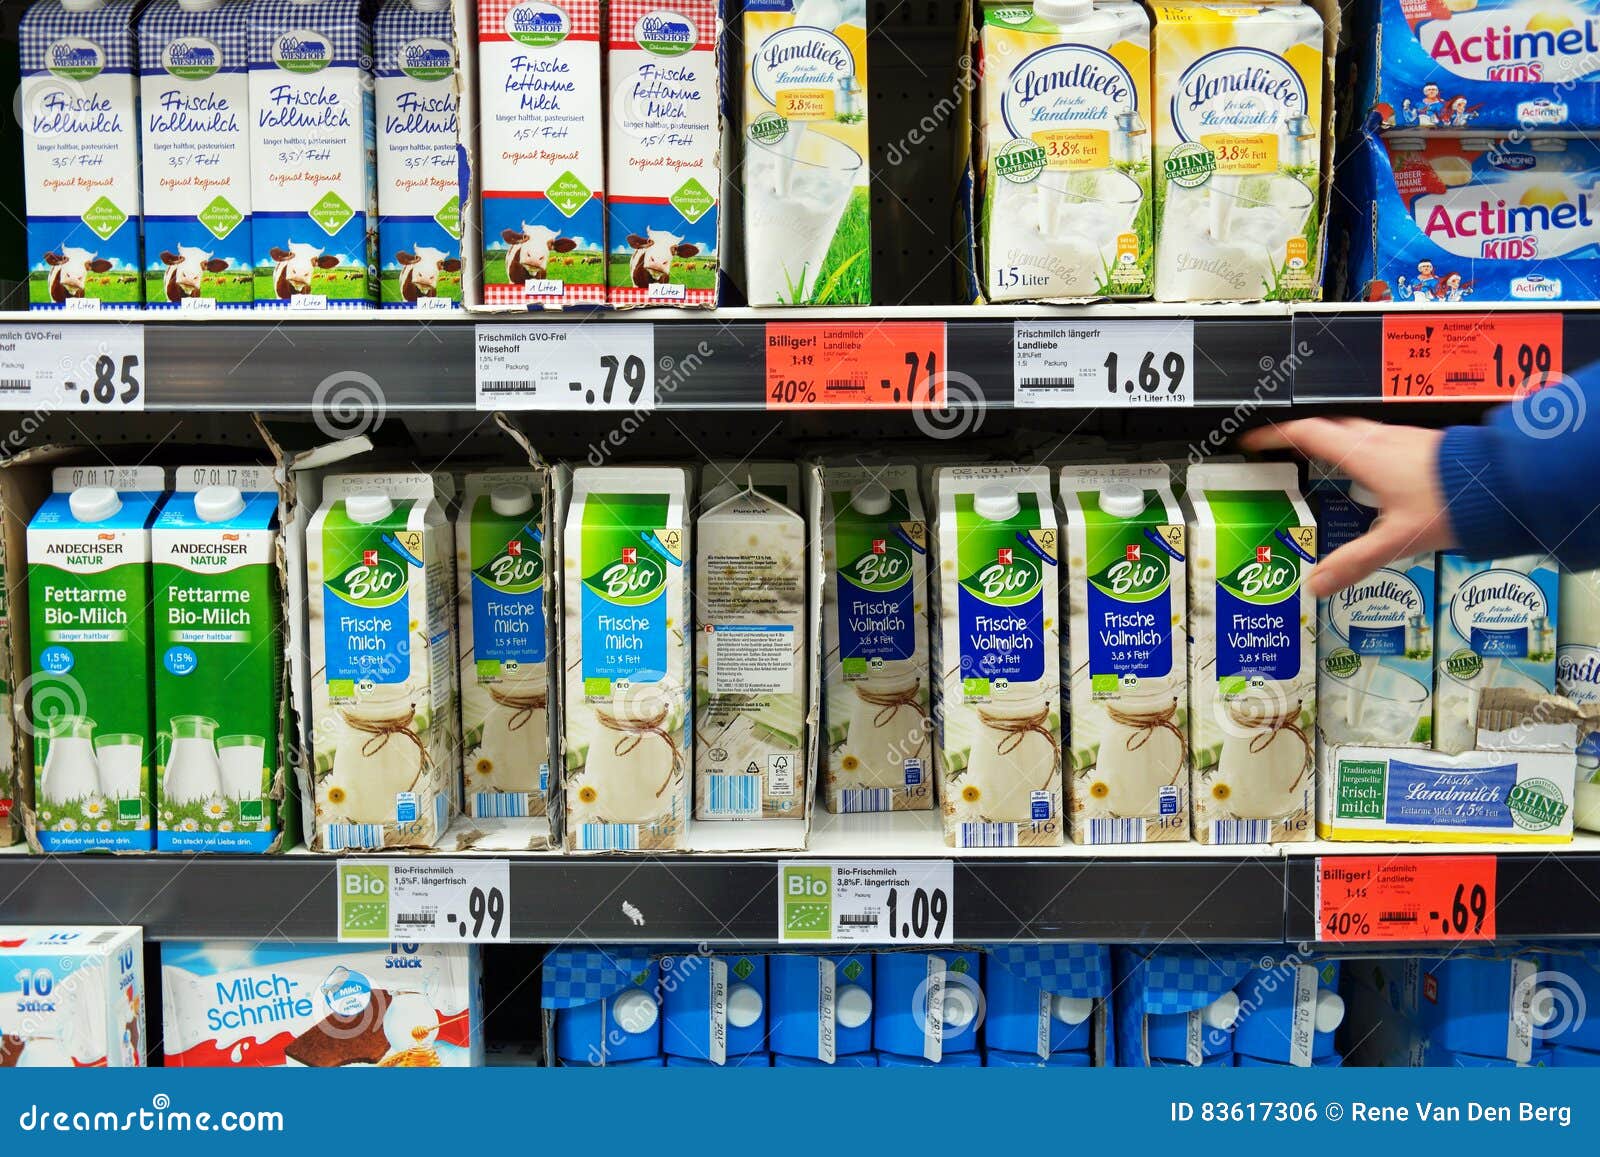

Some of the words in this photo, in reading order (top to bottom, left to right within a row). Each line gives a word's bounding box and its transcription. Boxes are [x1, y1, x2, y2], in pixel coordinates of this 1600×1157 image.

[514, 24, 563, 32] WIESEHOFF
[643, 33, 690, 42] WIESEHOFF
[1431, 20, 1593, 65] Actimel
[53, 58, 97, 67] WIESEHOFF
[170, 57, 215, 66] WIESEHOFF
[280, 51, 325, 60] WIESEHOFF
[407, 59, 450, 68] WIESEHOFF
[764, 40, 847, 71] Landliebe
[511, 56, 569, 73] Frische
[639, 64, 696, 81] Frische
[506, 74, 575, 93] fettarme
[776, 72, 834, 83] Landmilch
[1015, 63, 1128, 108] Landliebe
[270, 85, 339, 105] Frische
[633, 82, 700, 100] fettarme
[1185, 67, 1298, 111] Landliebe
[44, 92, 112, 112] Frische
[160, 90, 229, 111] Frische
[520, 94, 560, 110] Milch
[259, 108, 350, 128] Vollmilch
[647, 102, 686, 118] Milch
[1031, 106, 1108, 122] Landmilch
[1200, 110, 1278, 126] Landmilch
[33, 113, 123, 133] Vollmilch
[150, 112, 240, 133] Vollmilch
[1047, 142, 1080, 156] 3,8%
[1216, 146, 1249, 160] 3,8%
[996, 148, 1045, 167] OHNE
[1165, 152, 1214, 172] OHNE
[1425, 194, 1593, 239] Actimel
[1483, 238, 1536, 259] KIDS
[996, 267, 1019, 288] 1,5
[1022, 274, 1050, 286] Liter
[478, 333, 527, 341] Frischmilch
[529, 333, 567, 341] GVO-Frei
[824, 331, 863, 339] Landmilch
[1018, 330, 1066, 338] Frischmilch
[1387, 327, 1434, 343] Werbung!
[769, 336, 816, 349] Billiger!
[1104, 351, 1185, 394] 1.69
[1493, 344, 1550, 388] 1.99
[64, 355, 140, 404] -.85
[569, 355, 645, 405] -.79
[1392, 374, 1433, 396] 11%
[772, 380, 816, 403] 40%
[47, 544, 123, 554] ANDECHSER
[171, 545, 247, 554] ANDECHSER
[67, 555, 103, 565] NATUR
[191, 555, 227, 565] NATUR
[491, 555, 538, 586] Bio
[856, 554, 902, 584] Bio
[345, 566, 396, 599] Bio
[603, 564, 655, 598] Bio
[979, 564, 1031, 598] Bio
[1108, 560, 1159, 595] Bio
[1237, 563, 1289, 597] Bio
[45, 586, 127, 603] Fettarme
[168, 587, 250, 603] Fettarme
[1462, 582, 1540, 612] Landliebe
[45, 608, 127, 624] Bio-Milch
[488, 602, 535, 616] Frische
[853, 601, 899, 615] Frische
[1351, 610, 1405, 622] Landmilch
[169, 608, 250, 625] Bio-Milch
[341, 617, 391, 632] Frische
[598, 616, 649, 631] Frische
[975, 616, 1027, 631] Frische
[1105, 612, 1155, 627] Frische
[1233, 614, 1284, 630] Frische
[1472, 612, 1528, 624] Landmilch
[495, 619, 528, 633] Milch
[849, 618, 905, 632] Vollmilch
[349, 635, 385, 650] Milch
[606, 634, 642, 650] Milch
[971, 635, 1033, 650] Vollmilch
[1100, 630, 1162, 646] Vollmilch
[1228, 633, 1289, 648] Vollmilch
[1343, 767, 1382, 775] Traditionell
[1342, 786, 1382, 798] Frisch-
[1405, 782, 1500, 803] Landmilch
[1341, 803, 1379, 814] milch
[1511, 785, 1566, 818] OHNE
[346, 874, 384, 894] Bio
[422, 877, 467, 886] längerfrisch
[864, 878, 909, 888] längerfrisch
[1323, 870, 1371, 883] Billiger!
[788, 875, 827, 895] Bio
[447, 887, 504, 938] -.99
[887, 888, 947, 939] 1.09
[1429, 883, 1486, 935] -.69
[1327, 912, 1370, 935] 40%
[119, 949, 133, 974] 10
[385, 956, 422, 968] Stück
[16, 968, 53, 996] 10
[216, 974, 298, 1005] Milch-
[340, 983, 362, 997] Milch
[207, 997, 313, 1031] Schnitte
